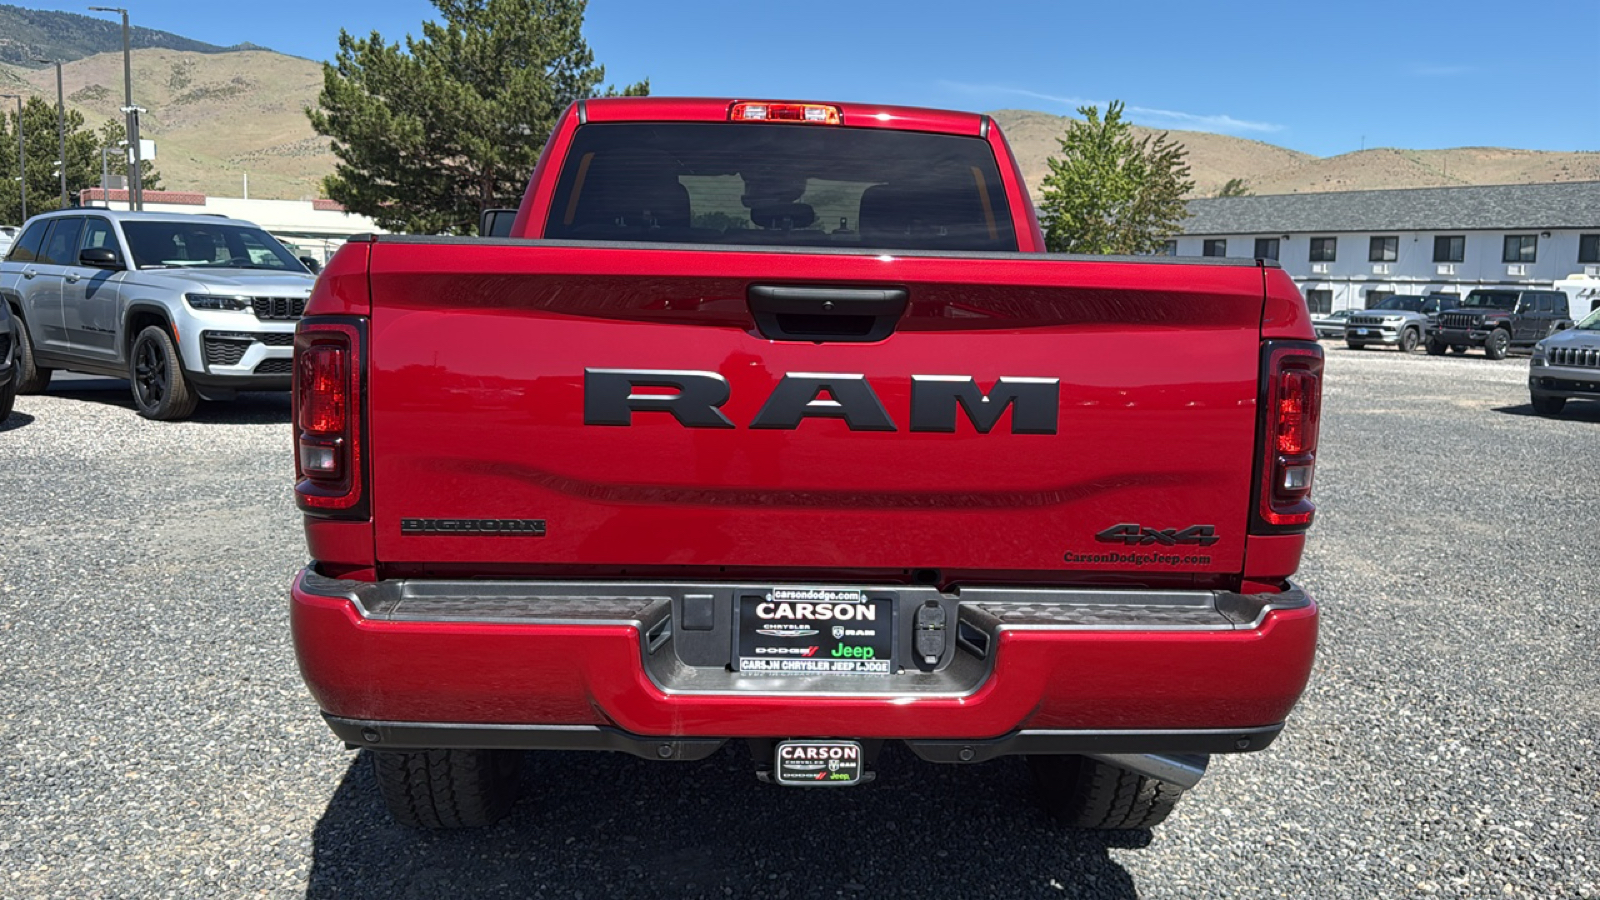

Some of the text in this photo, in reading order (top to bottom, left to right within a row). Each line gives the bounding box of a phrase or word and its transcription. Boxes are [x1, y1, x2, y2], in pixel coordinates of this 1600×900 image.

[583, 367, 1060, 434] RAM
[1094, 522, 1220, 547] 4x4
[1063, 551, 1211, 565] CarsonDodgeJeep.com
[775, 589, 859, 600] carsondodge.com
[756, 603, 876, 620] CARSON
[831, 642, 875, 660] Jeep
[781, 660, 830, 671] CHRYSLER
[831, 661, 855, 671] JEEP
[782, 747, 857, 759] CARSON
[830, 771, 850, 780] Jeep
